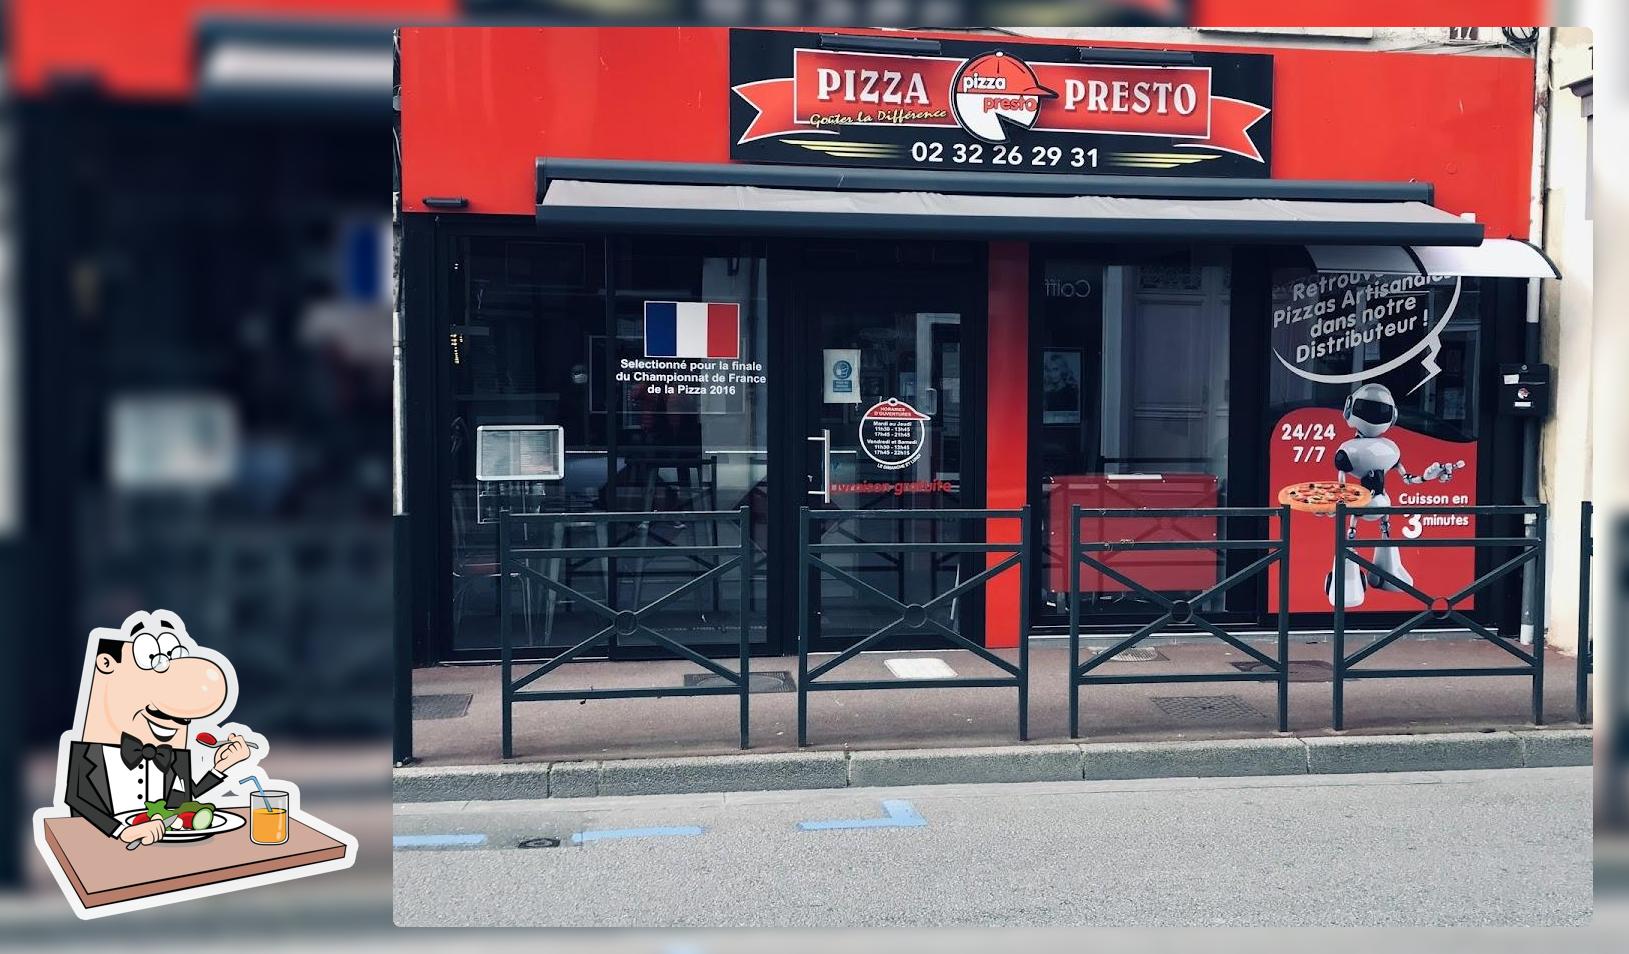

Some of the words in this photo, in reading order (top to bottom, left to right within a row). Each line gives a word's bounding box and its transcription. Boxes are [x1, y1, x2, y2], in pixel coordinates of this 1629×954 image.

[817, 68, 929, 105] PIZZA
[963, 72, 1006, 93] pizza
[983, 95, 1037, 113] presto
[1064, 79, 1197, 115] PRESTO
[912, 142, 944, 162] 02
[952, 143, 984, 164] 32
[992, 145, 1023, 165] 26
[1031, 146, 1062, 166] 29
[1070, 147, 1098, 168] 31
[1293, 273, 1385, 302] Retrouv
[1273, 297, 1336, 328] Pizzas
[1341, 275, 1453, 309] Artisana
[1310, 312, 1357, 338] dans
[1362, 296, 1417, 324] notre
[1296, 314, 1418, 363] Distributeur
[620, 359, 687, 370] Selectionné
[690, 361, 716, 372] pour
[719, 361, 729, 370] la
[732, 361, 762, 371] finale
[616, 372, 630, 381] du
[634, 372, 709, 384] Championnat
[712, 373, 726, 382] de
[729, 373, 767, 384] France
[647, 385, 661, 394] de
[665, 385, 674, 394] la
[678, 385, 707, 395] Pizza
[709, 385, 736, 395] 2016
[1282, 423, 1337, 441] 24/24
[1293, 446, 1326, 463] 7/7
[1399, 492, 1449, 505] Cuisson
[1452, 494, 1468, 505] en
[1402, 514, 1423, 539] 3
[1423, 514, 1469, 527] minutes
